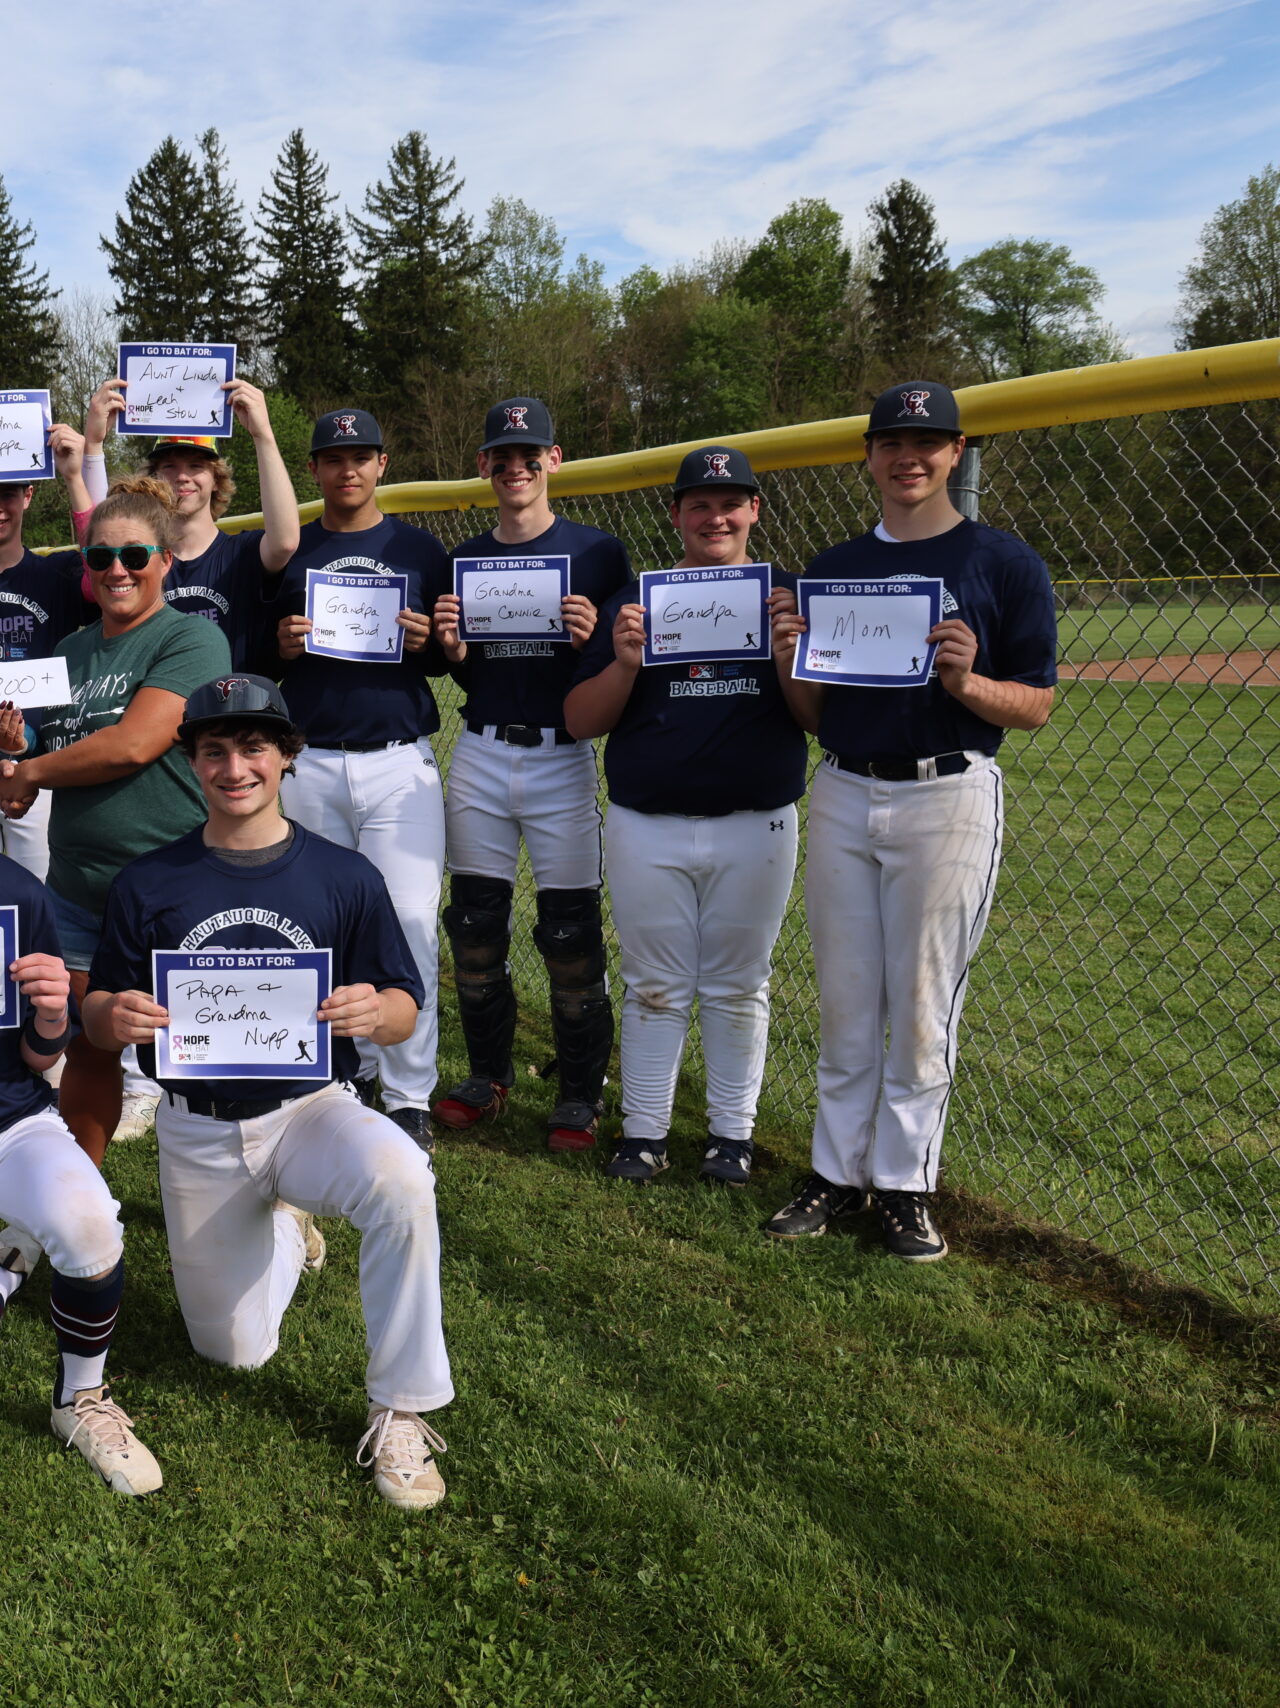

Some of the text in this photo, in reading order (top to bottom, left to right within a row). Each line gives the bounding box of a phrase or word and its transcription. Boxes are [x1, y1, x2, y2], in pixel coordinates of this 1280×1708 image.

[193, 348, 212, 356] FOR:
[147, 394, 178, 406] Leah
[166, 407, 197, 419] Stow
[702, 571, 720, 579] BAT
[723, 570, 743, 578] FOR:
[475, 582, 535, 600] Grandma
[826, 585, 911, 593] I GO TO BAT FOR:
[22, 597, 49, 623] LAKE
[326, 596, 379, 618] Grandpa
[663, 601, 738, 628] Grandpa
[321, 629, 336, 637] HOPE
[345, 624, 380, 638] Bud
[832, 610, 891, 645] Mom
[11, 631, 33, 643] BAT
[484, 642, 554, 658] BASEBALL
[819, 650, 842, 658] HOPE
[670, 678, 760, 697] BASEBALL
[64, 703, 87, 731] and
[178, 908, 315, 950] HAUTAUQUA LAK
[189, 957, 295, 967] I GO TO BAT FOR:
[195, 1004, 272, 1023] Grandma
[184, 1035, 210, 1045] HOPE
